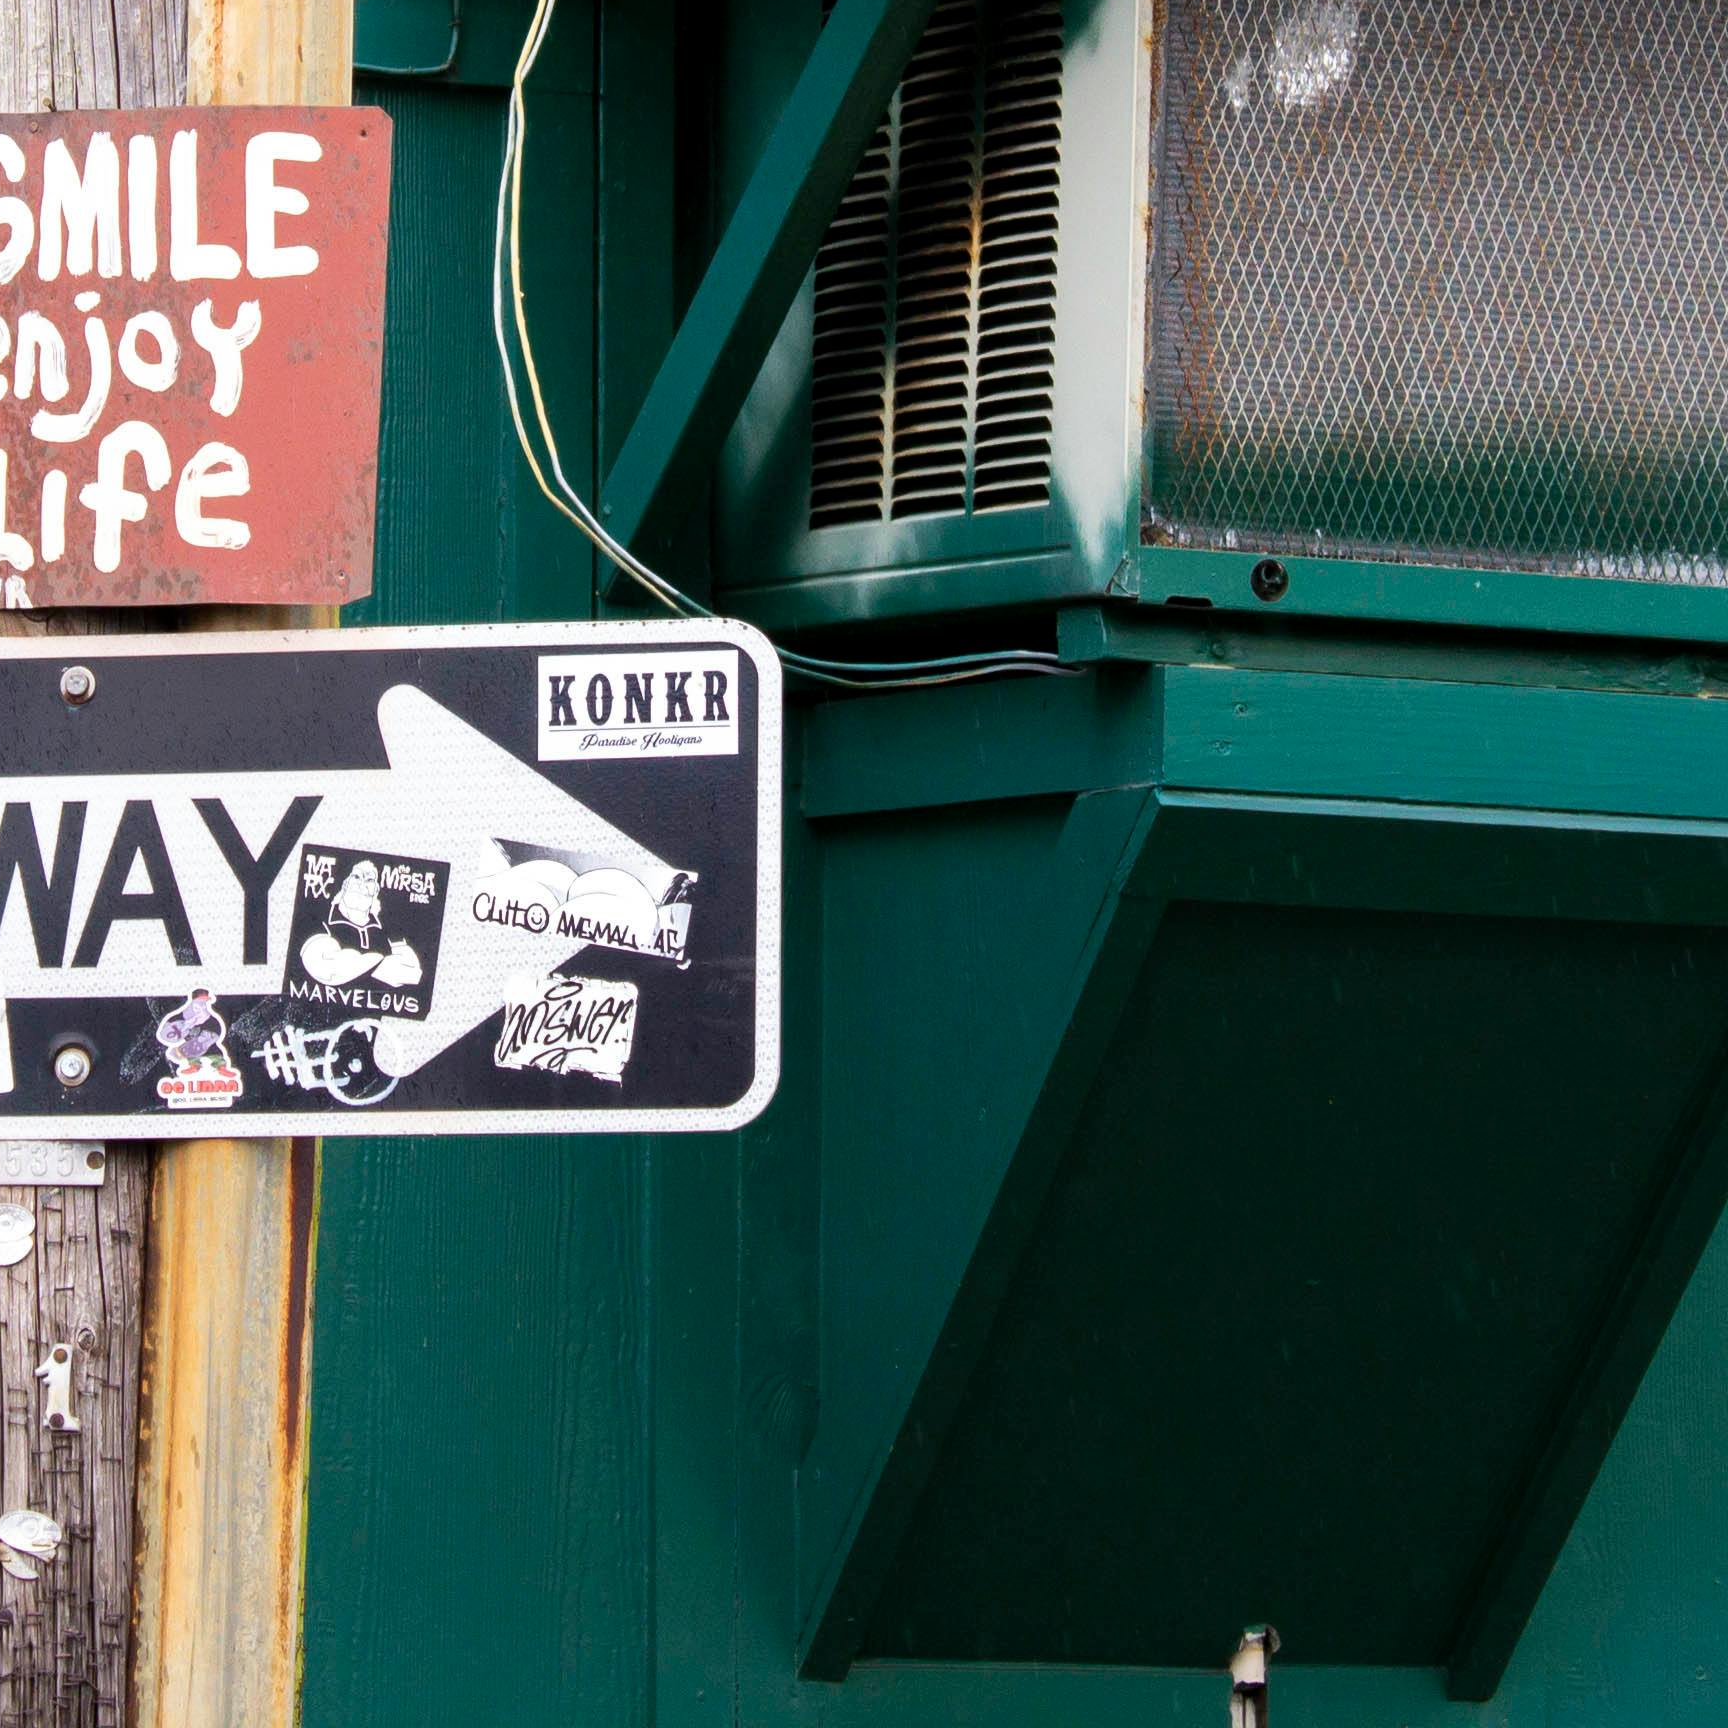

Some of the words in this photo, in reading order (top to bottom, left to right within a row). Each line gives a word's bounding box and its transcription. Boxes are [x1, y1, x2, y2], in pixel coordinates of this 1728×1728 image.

[549, 671, 729, 726] KONKR
[579, 733, 637, 751] Paradise
[640, 732, 703, 751] Hooligans
[380, 864, 435, 896] MRSA
[289, 979, 420, 1013] MARVELOUS
